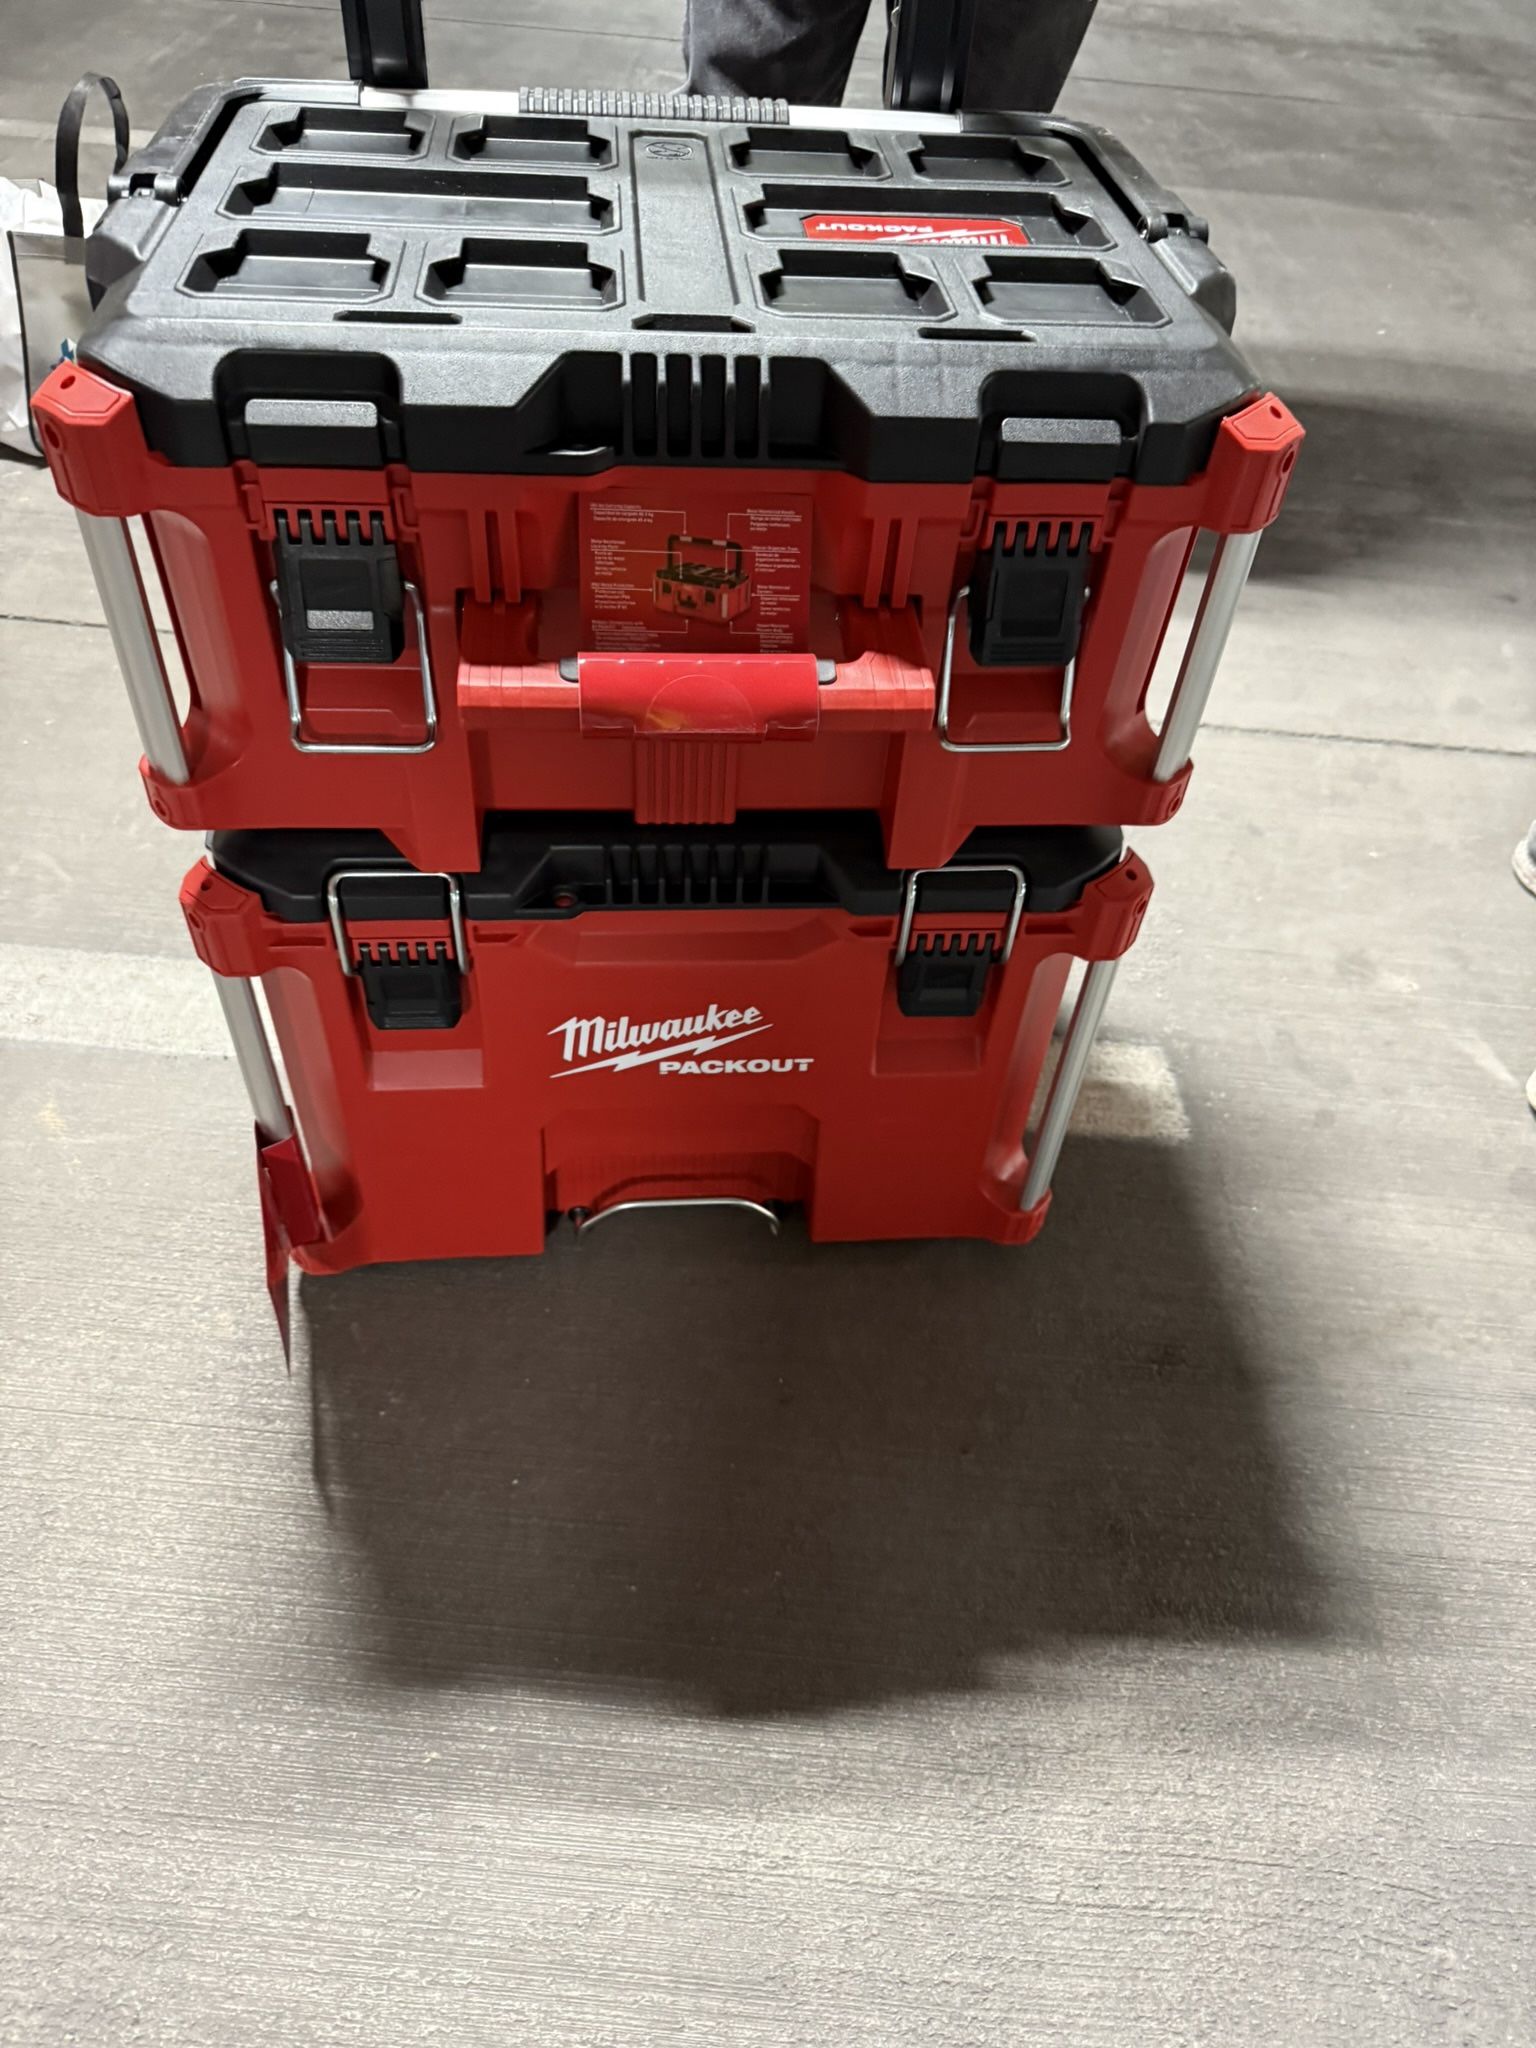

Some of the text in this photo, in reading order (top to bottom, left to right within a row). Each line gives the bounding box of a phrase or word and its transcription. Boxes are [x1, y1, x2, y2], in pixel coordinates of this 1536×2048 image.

[816, 222, 934, 234] PACKOUT
[547, 1004, 764, 1062] Milwaukee
[659, 1058, 814, 1075] PACKOUT
